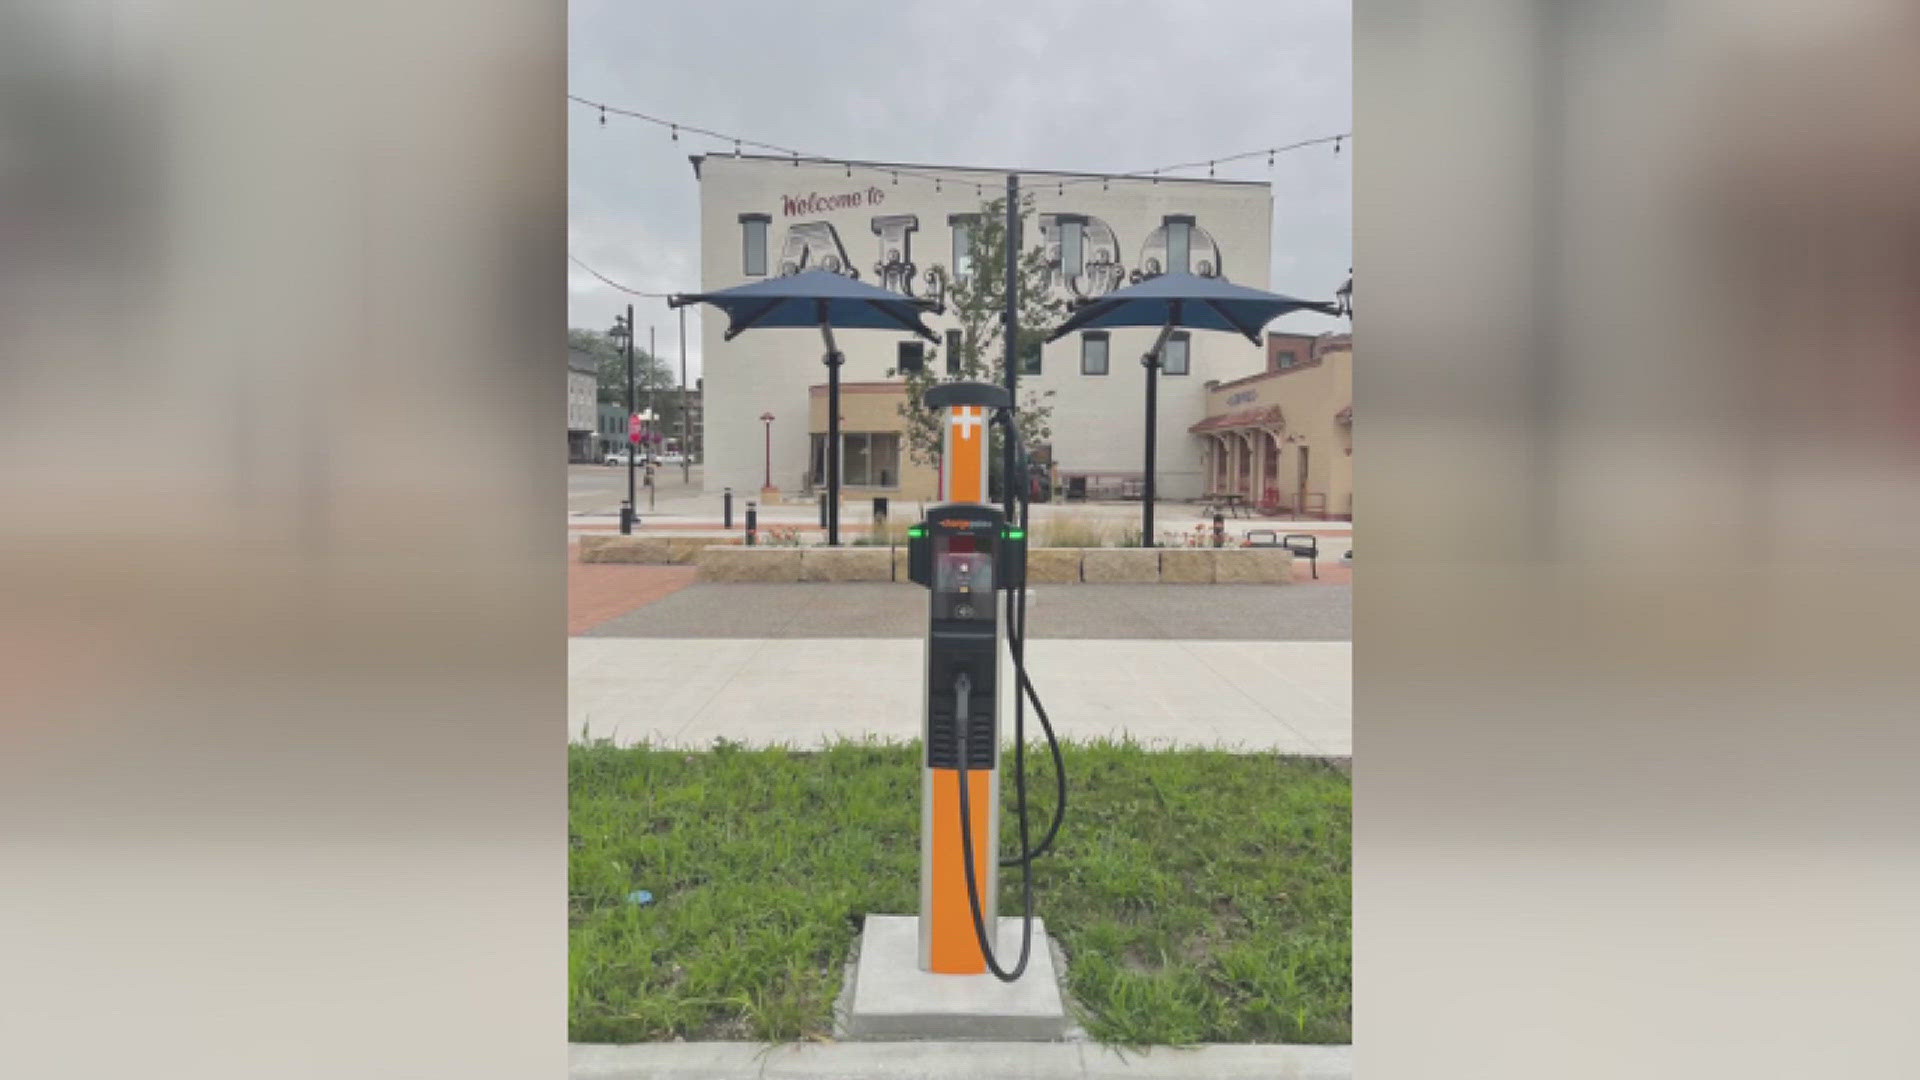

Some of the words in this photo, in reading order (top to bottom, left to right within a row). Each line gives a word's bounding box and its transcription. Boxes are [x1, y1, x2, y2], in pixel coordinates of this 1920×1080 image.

[780, 191, 862, 216] Welcome
[863, 186, 885, 206] to
[778, 214, 1222, 311] ALDO
